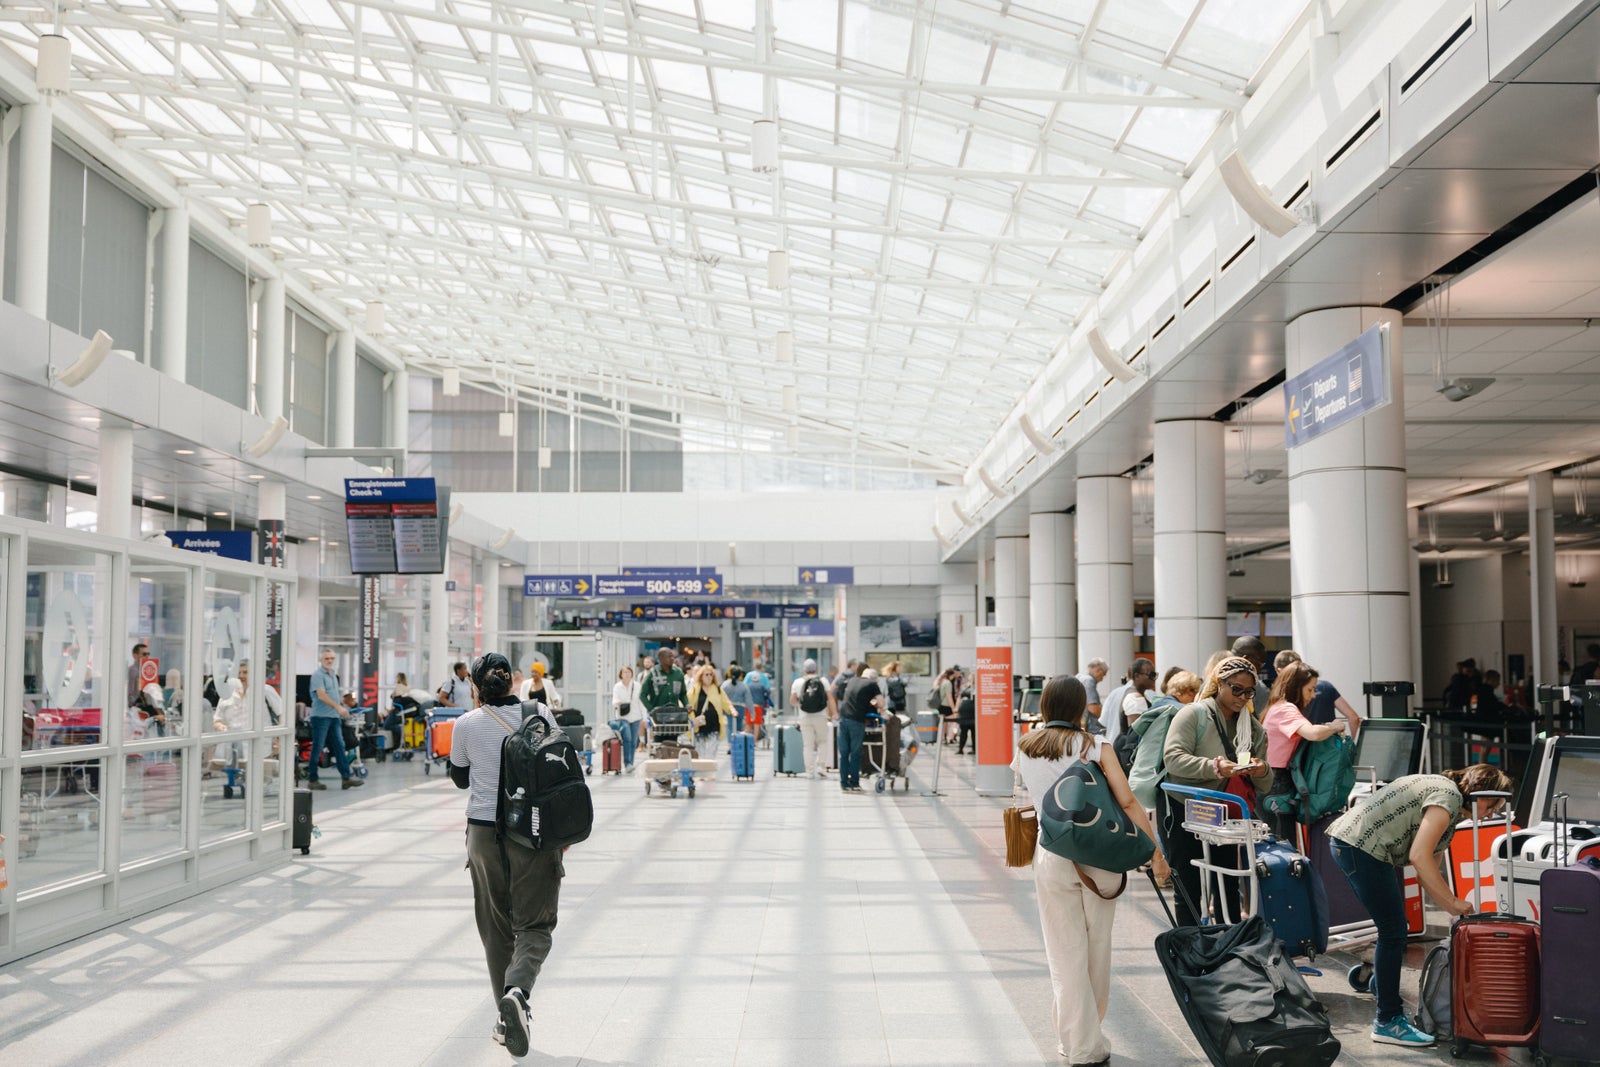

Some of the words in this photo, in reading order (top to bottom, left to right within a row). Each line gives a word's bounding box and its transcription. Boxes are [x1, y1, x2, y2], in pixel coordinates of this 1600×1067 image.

[1314, 374, 1337, 399] Départs
[1315, 396, 1347, 423] Departures
[349, 480, 406, 489] Enregistrement
[183, 539, 221, 548] Arrivées
[646, 580, 702, 593] 500-599
[364, 577, 372, 626] RENCONTRE
[680, 606, 690, 618] C
[364, 627, 371, 638] DE
[363, 639, 371, 664] POINT
[532, 806, 540, 836] PUMA
